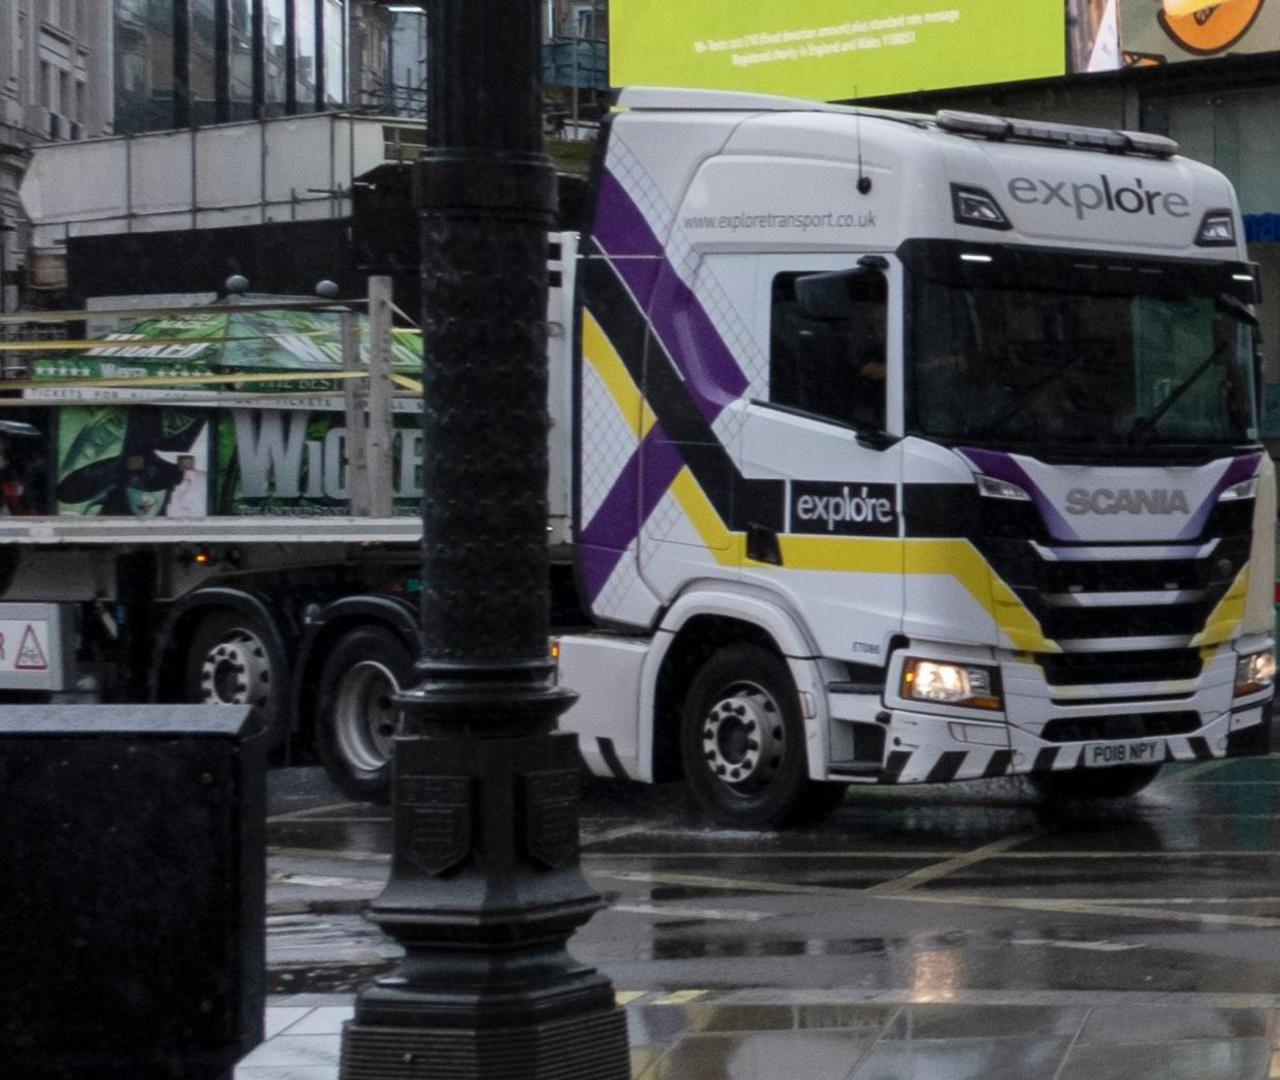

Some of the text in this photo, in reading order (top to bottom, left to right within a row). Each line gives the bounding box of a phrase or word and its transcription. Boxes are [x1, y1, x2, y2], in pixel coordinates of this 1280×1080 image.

[684, 210, 877, 231] www.exploretransport.co.uk
[1065, 487, 1191, 516] SCANIA
[1129, 742, 1158, 760] NPY
